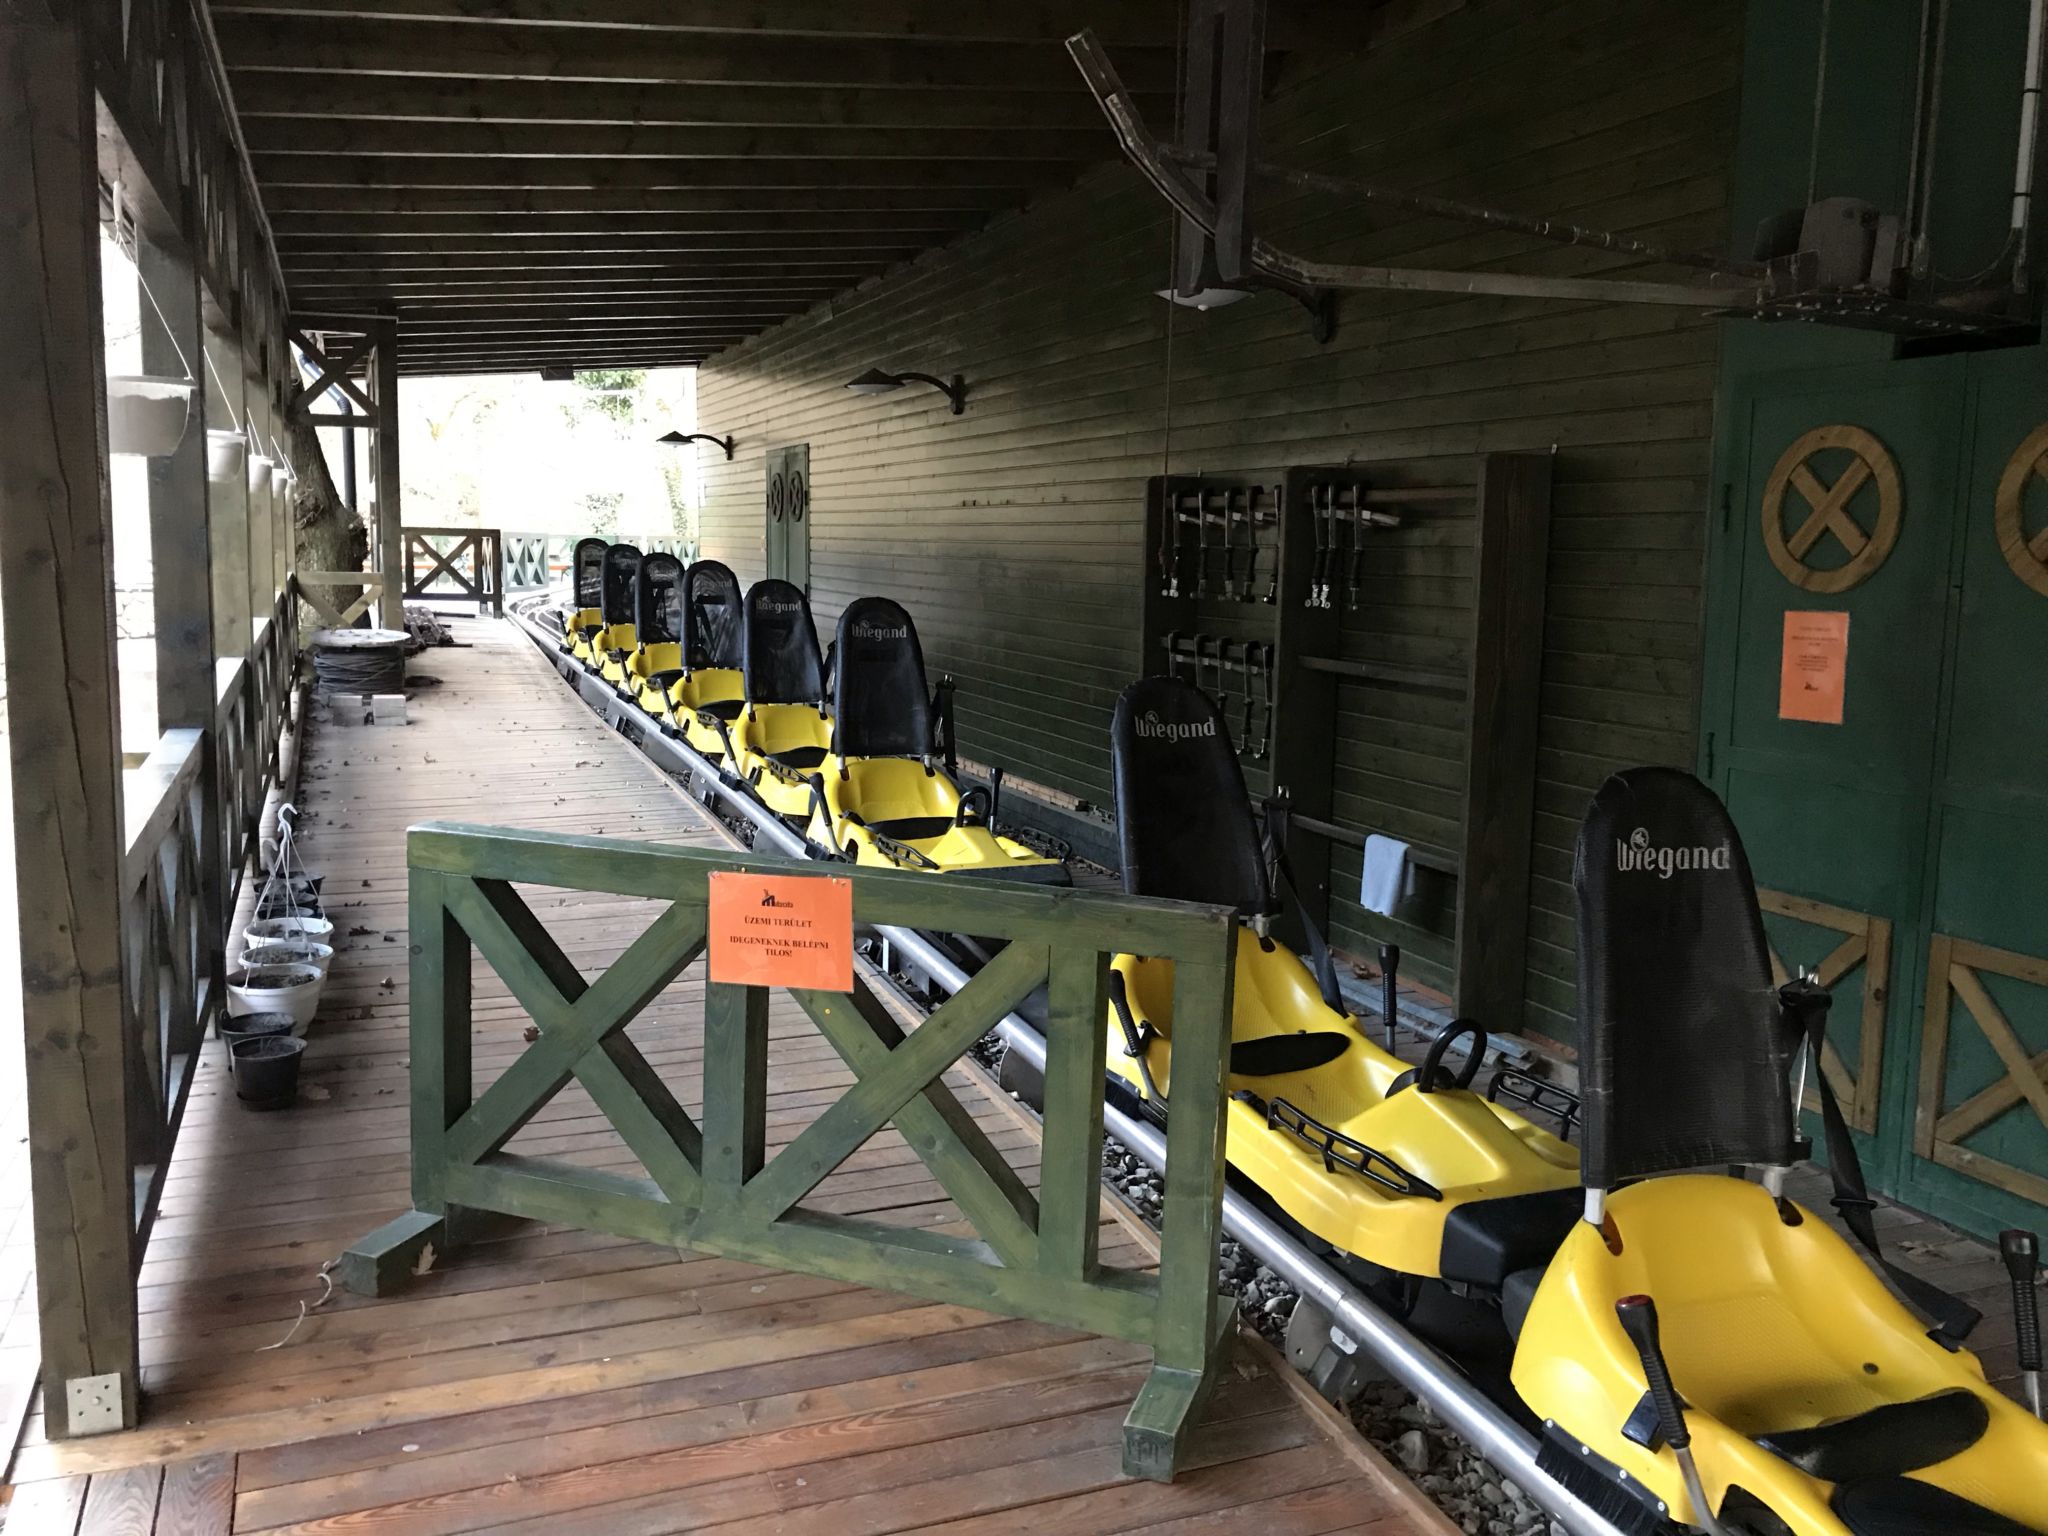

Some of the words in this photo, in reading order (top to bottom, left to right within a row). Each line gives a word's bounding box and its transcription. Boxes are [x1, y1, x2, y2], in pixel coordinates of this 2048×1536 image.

[851, 620, 907, 641] Wiegand
[1134, 711, 1216, 743] Wiegand
[1616, 828, 1730, 879] Wiegand
[730, 935, 790, 947] IDEGENEKNEK
[765, 948, 792, 957] TILOS!
